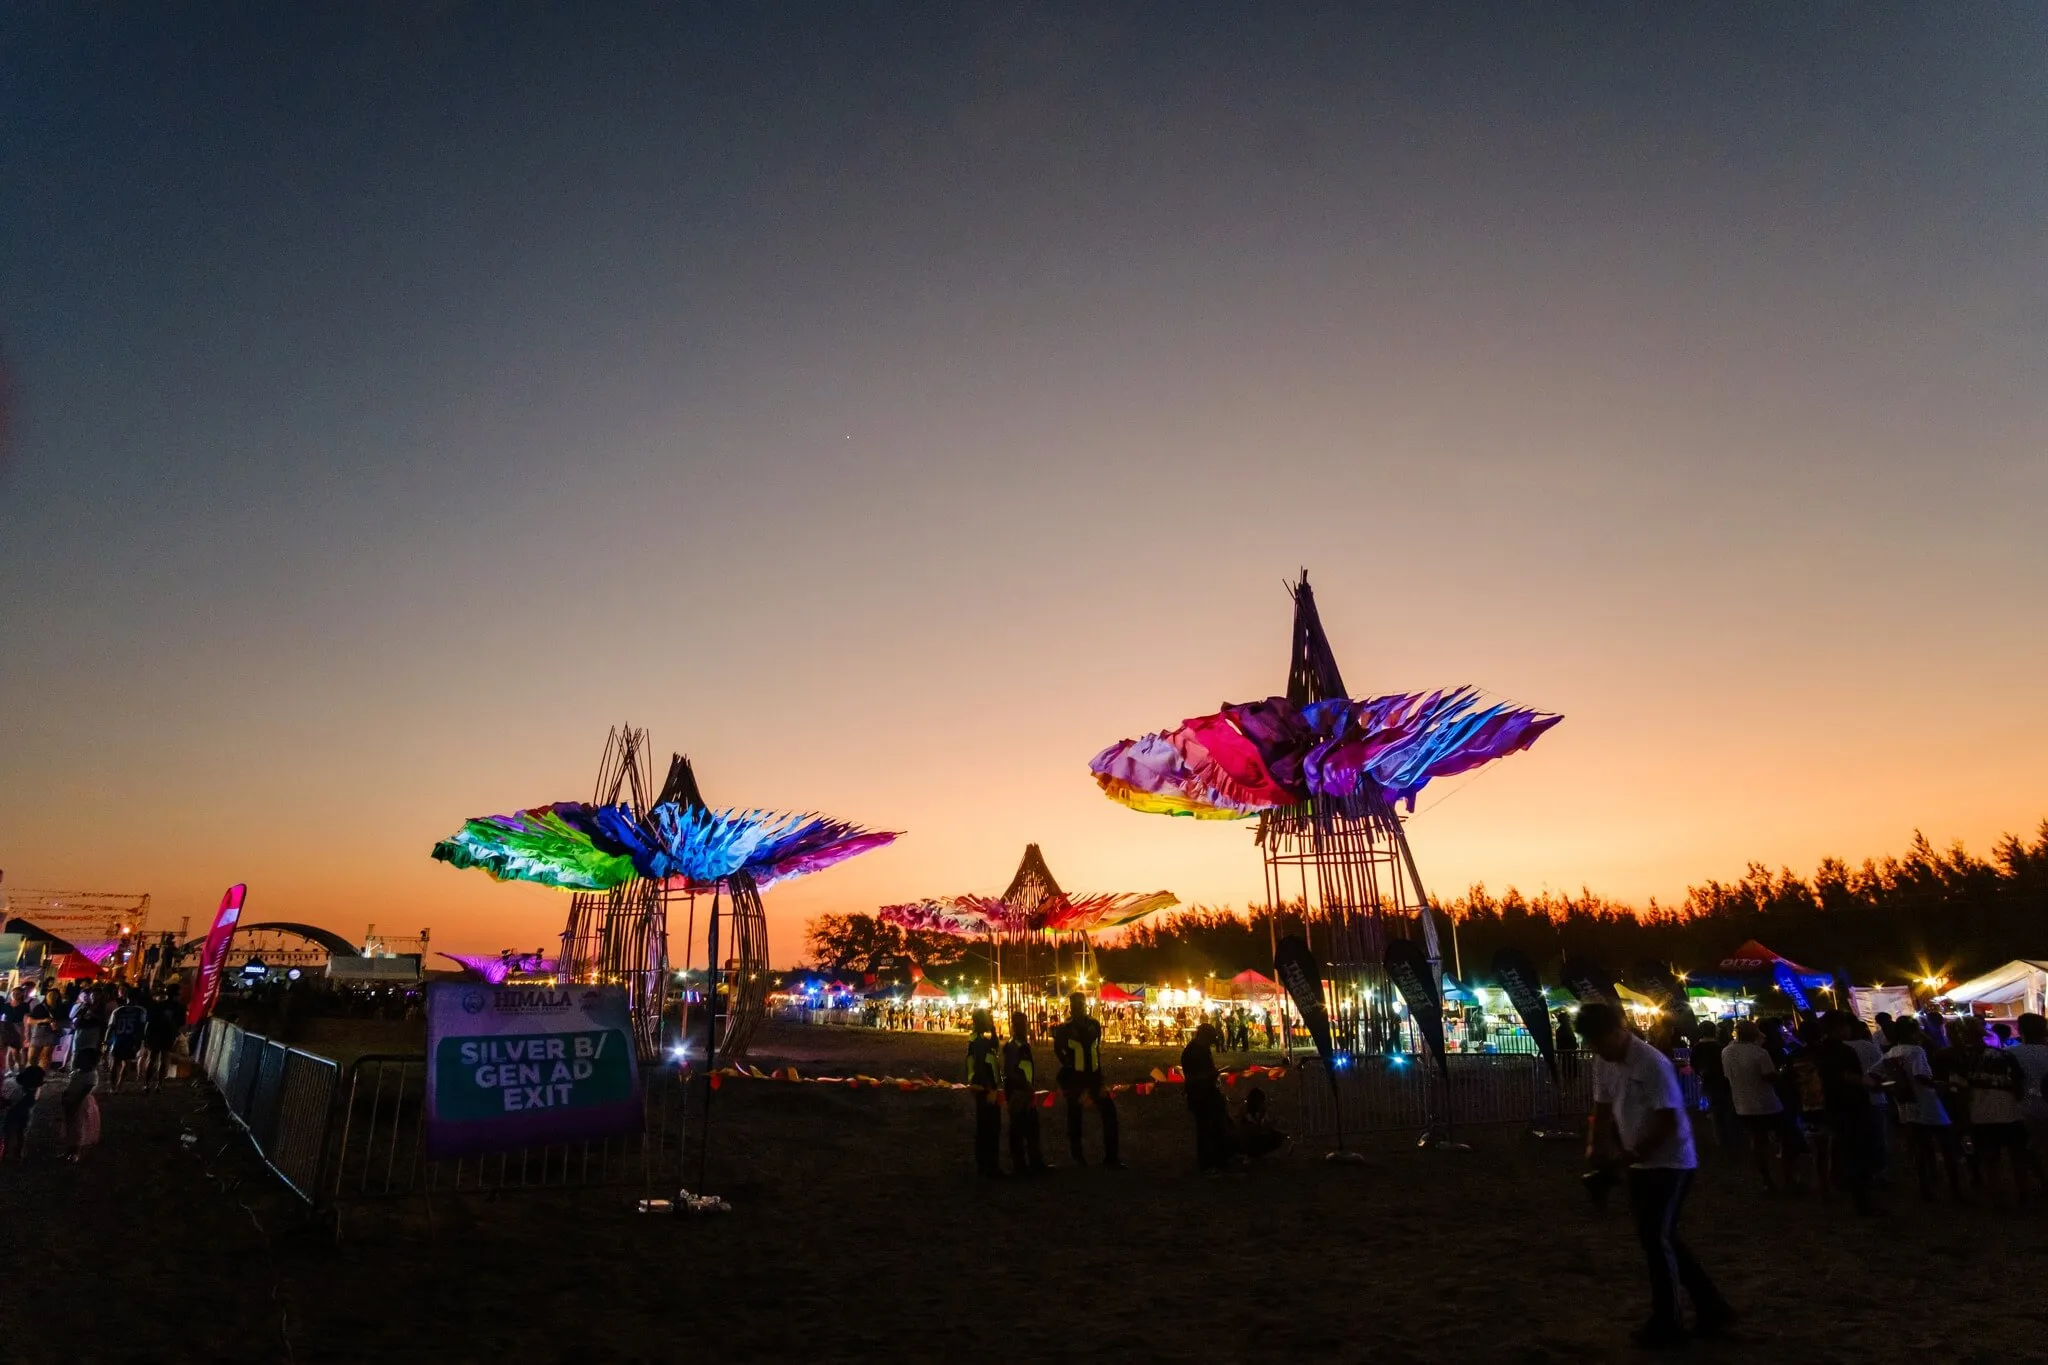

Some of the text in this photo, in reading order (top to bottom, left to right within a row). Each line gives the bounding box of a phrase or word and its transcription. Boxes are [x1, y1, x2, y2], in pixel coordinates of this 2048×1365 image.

[494, 991, 572, 1007] HIMALA
[460, 1033, 608, 1065] SILVER B/
[475, 1060, 593, 1088] GEN AD
[503, 1082, 573, 1111] EXIT
